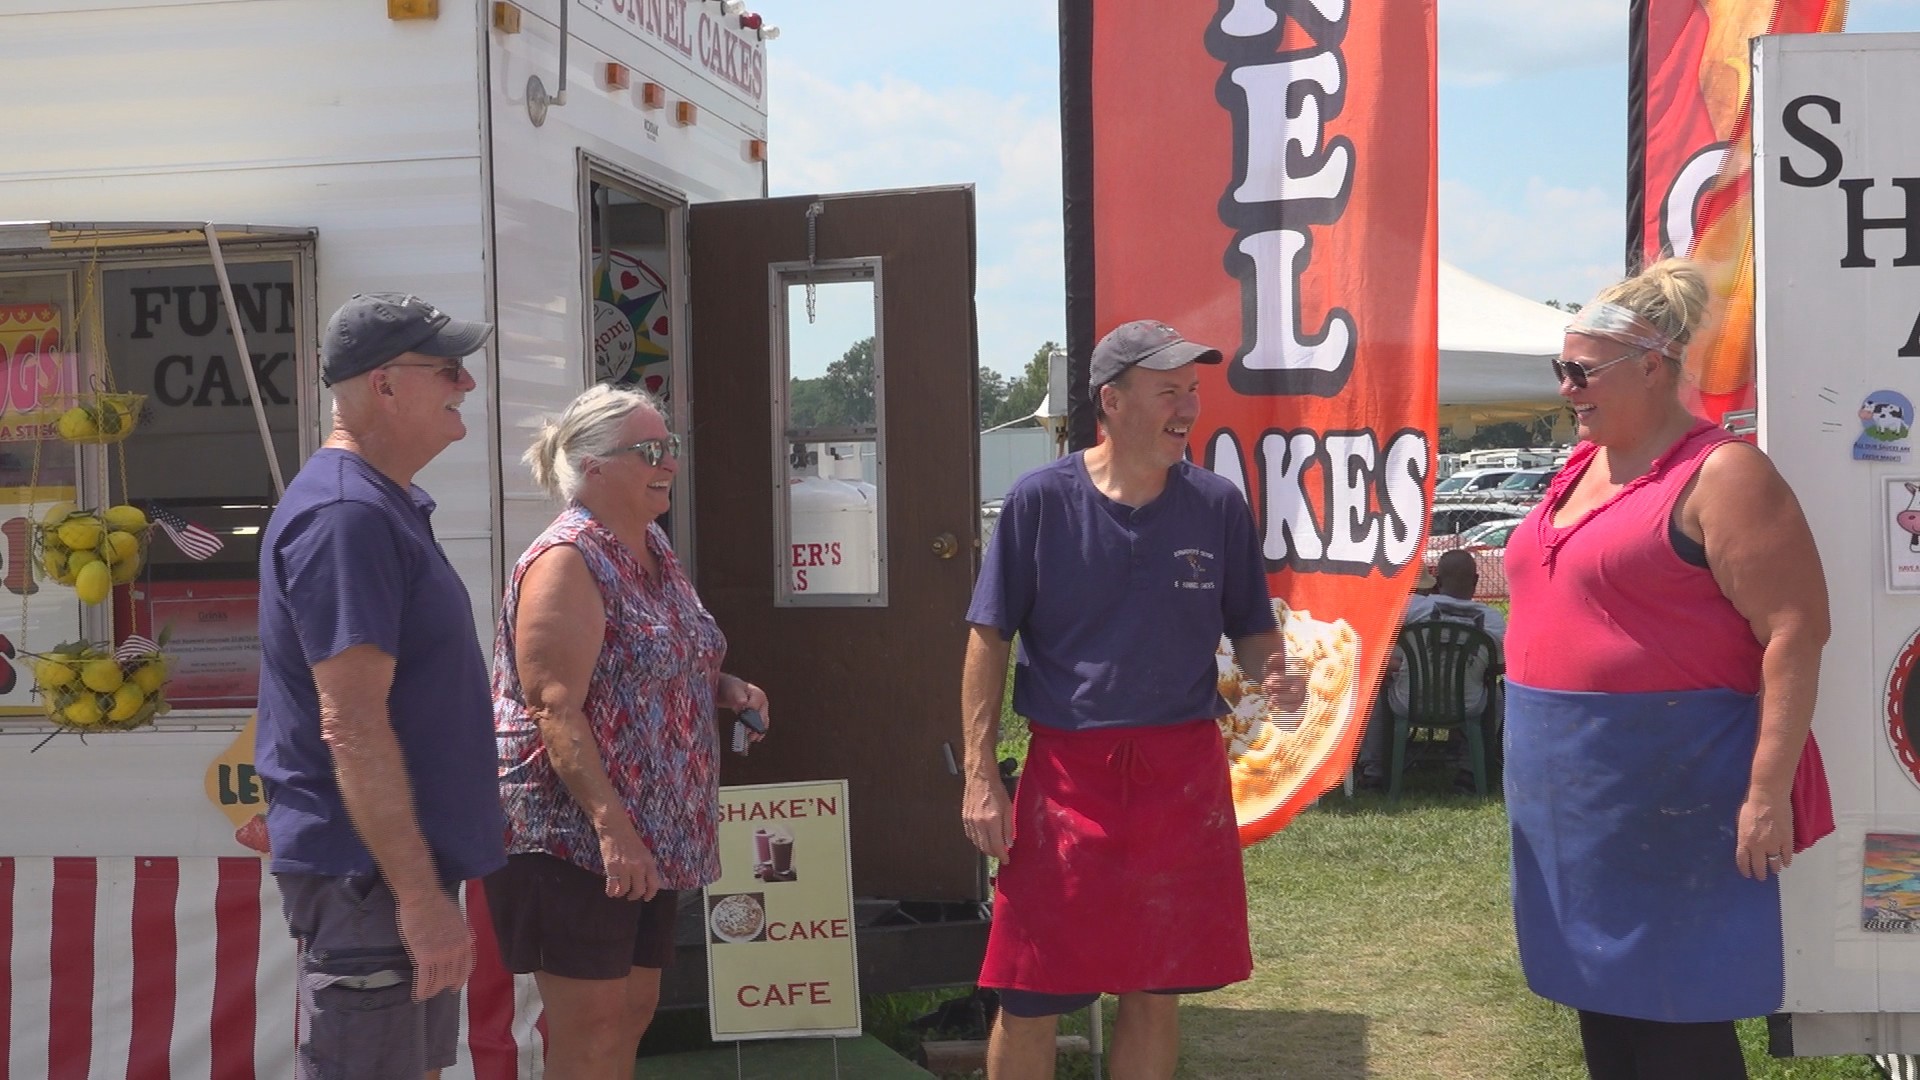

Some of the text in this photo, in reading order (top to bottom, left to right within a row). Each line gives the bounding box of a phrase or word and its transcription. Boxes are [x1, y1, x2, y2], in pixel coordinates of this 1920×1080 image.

[698, 13, 762, 101] CAKES
[154, 352, 298, 407] CAK
[792, 569, 808, 591] S
[218, 763, 269, 805] LE
[767, 919, 848, 941] CAKE
[737, 981, 831, 1007] CAFE
